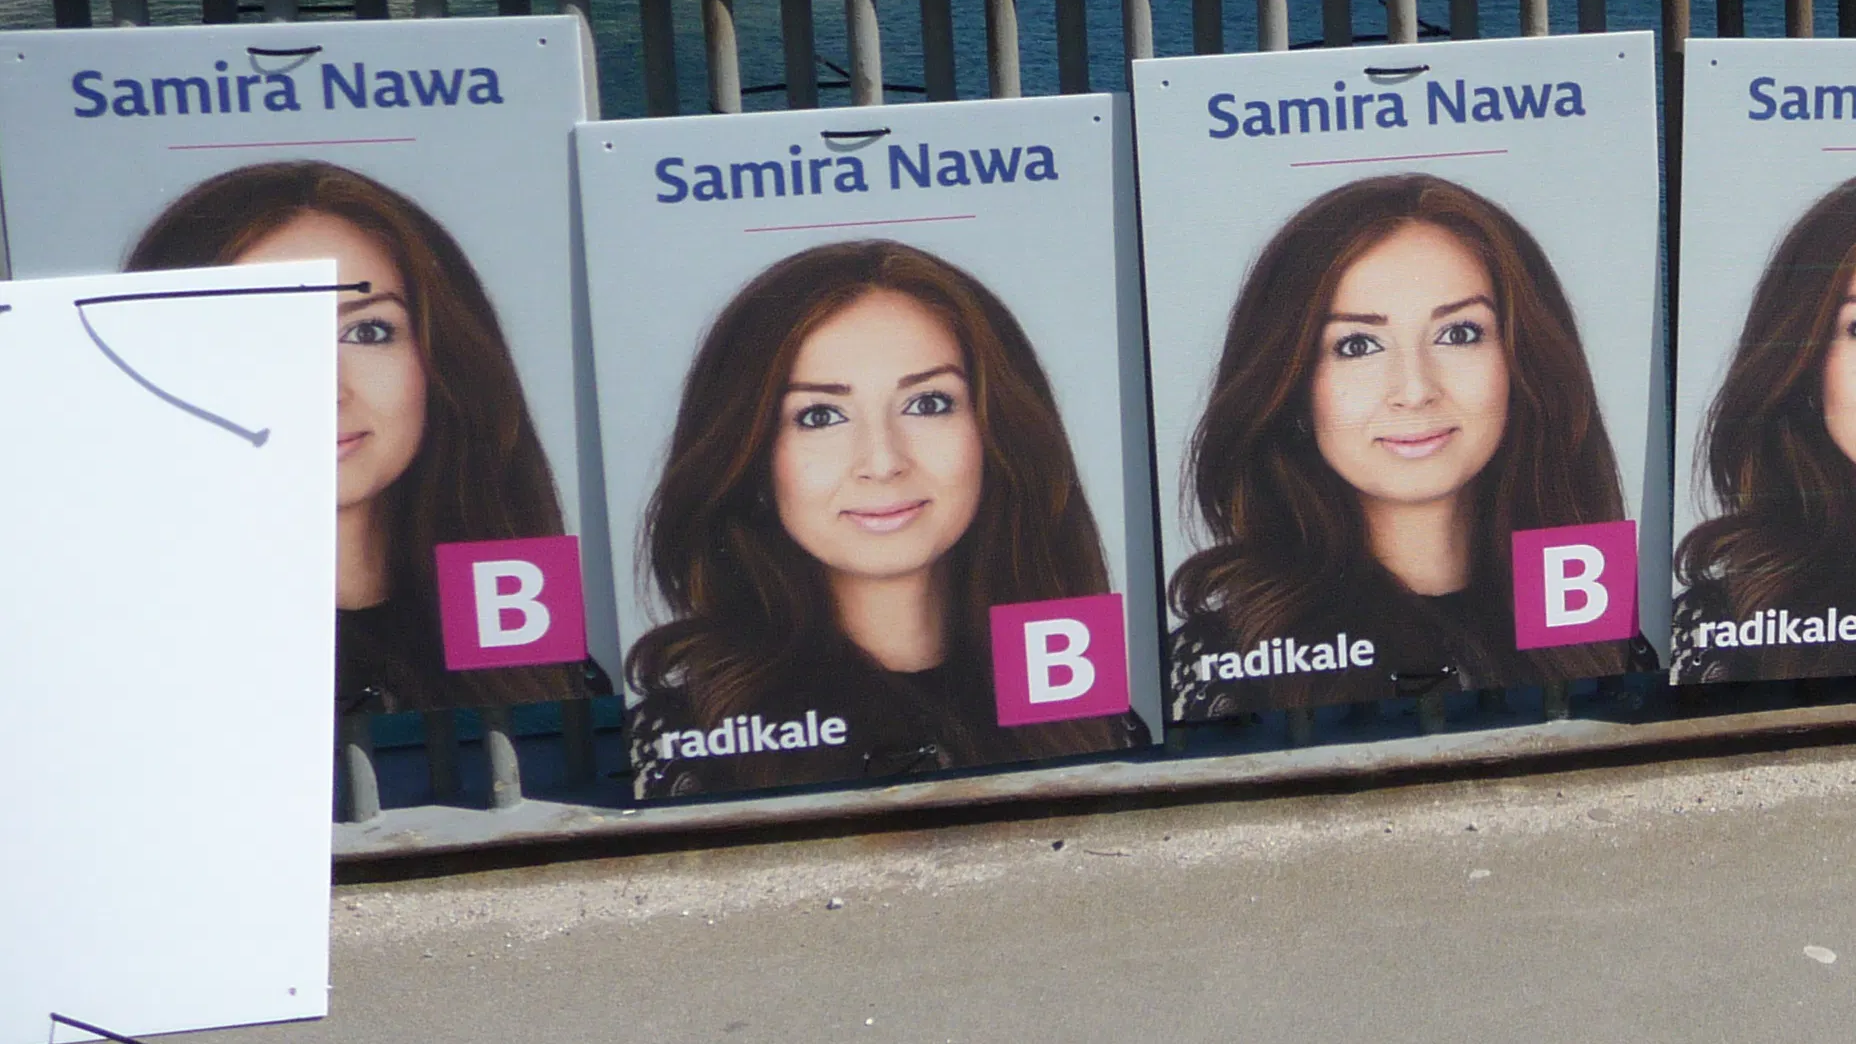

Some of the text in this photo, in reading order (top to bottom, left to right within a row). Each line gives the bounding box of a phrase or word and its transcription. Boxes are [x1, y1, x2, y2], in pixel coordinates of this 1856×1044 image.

[72, 60, 505, 118] Samira Nawa
[1207, 79, 1587, 139] Samira Nawa
[654, 142, 1059, 204] Samira Nawa
[472, 559, 550, 648] B
[1543, 543, 1609, 628] B
[1023, 617, 1097, 704] B
[1198, 632, 1376, 682] radikale
[660, 709, 848, 761] radikale
